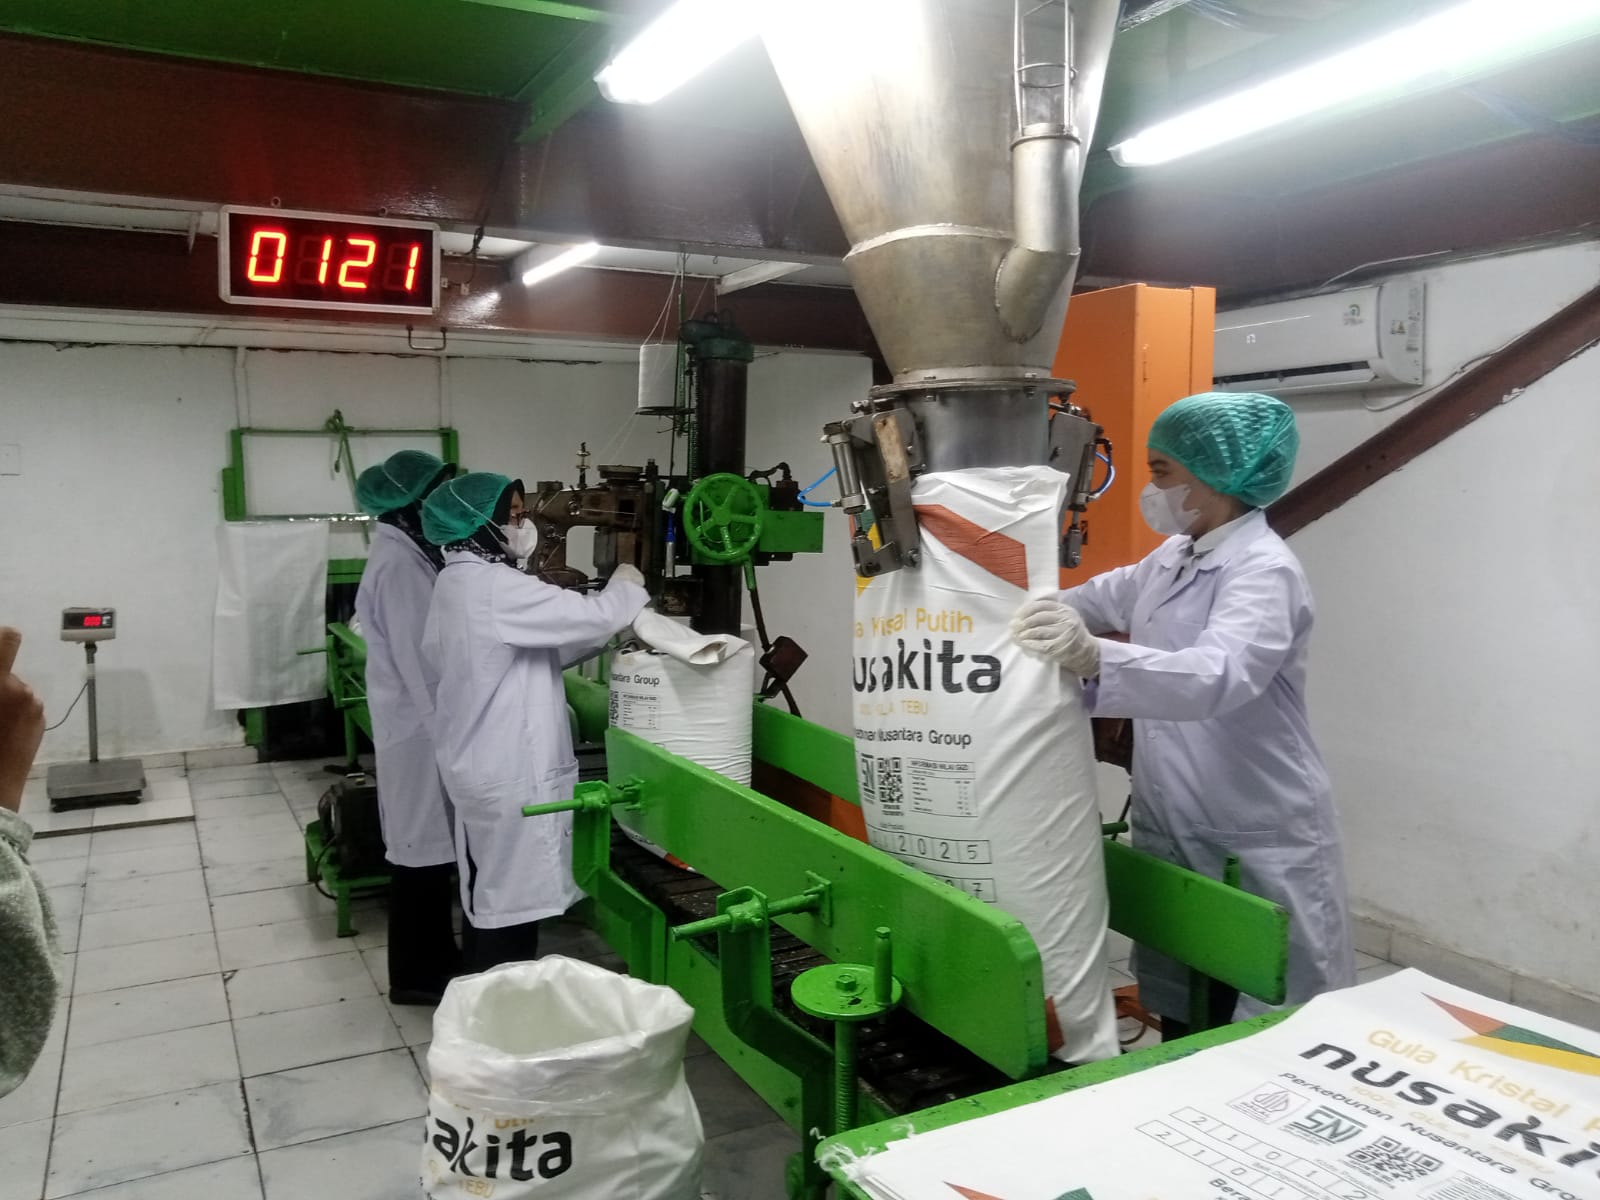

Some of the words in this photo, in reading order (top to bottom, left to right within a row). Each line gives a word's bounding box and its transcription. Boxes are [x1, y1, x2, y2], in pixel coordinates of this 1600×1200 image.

[247, 231, 420, 291] 0121
[916, 608, 973, 633] Putih
[634, 674, 660, 687] Group
[929, 729, 972, 749] Group
[1368, 1029, 1437, 1064] Gula
[1450, 1060, 1571, 1118] Kristal
[1278, 1072, 1394, 1121] Perkebunan
[1400, 1122, 1517, 1174] Nusantara
[1529, 1178, 1584, 1200] Gro
[1299, 1042, 1600, 1180] nusaki
[1304, 1108, 1364, 1143] SNI
[424, 1116, 573, 1182] akita
